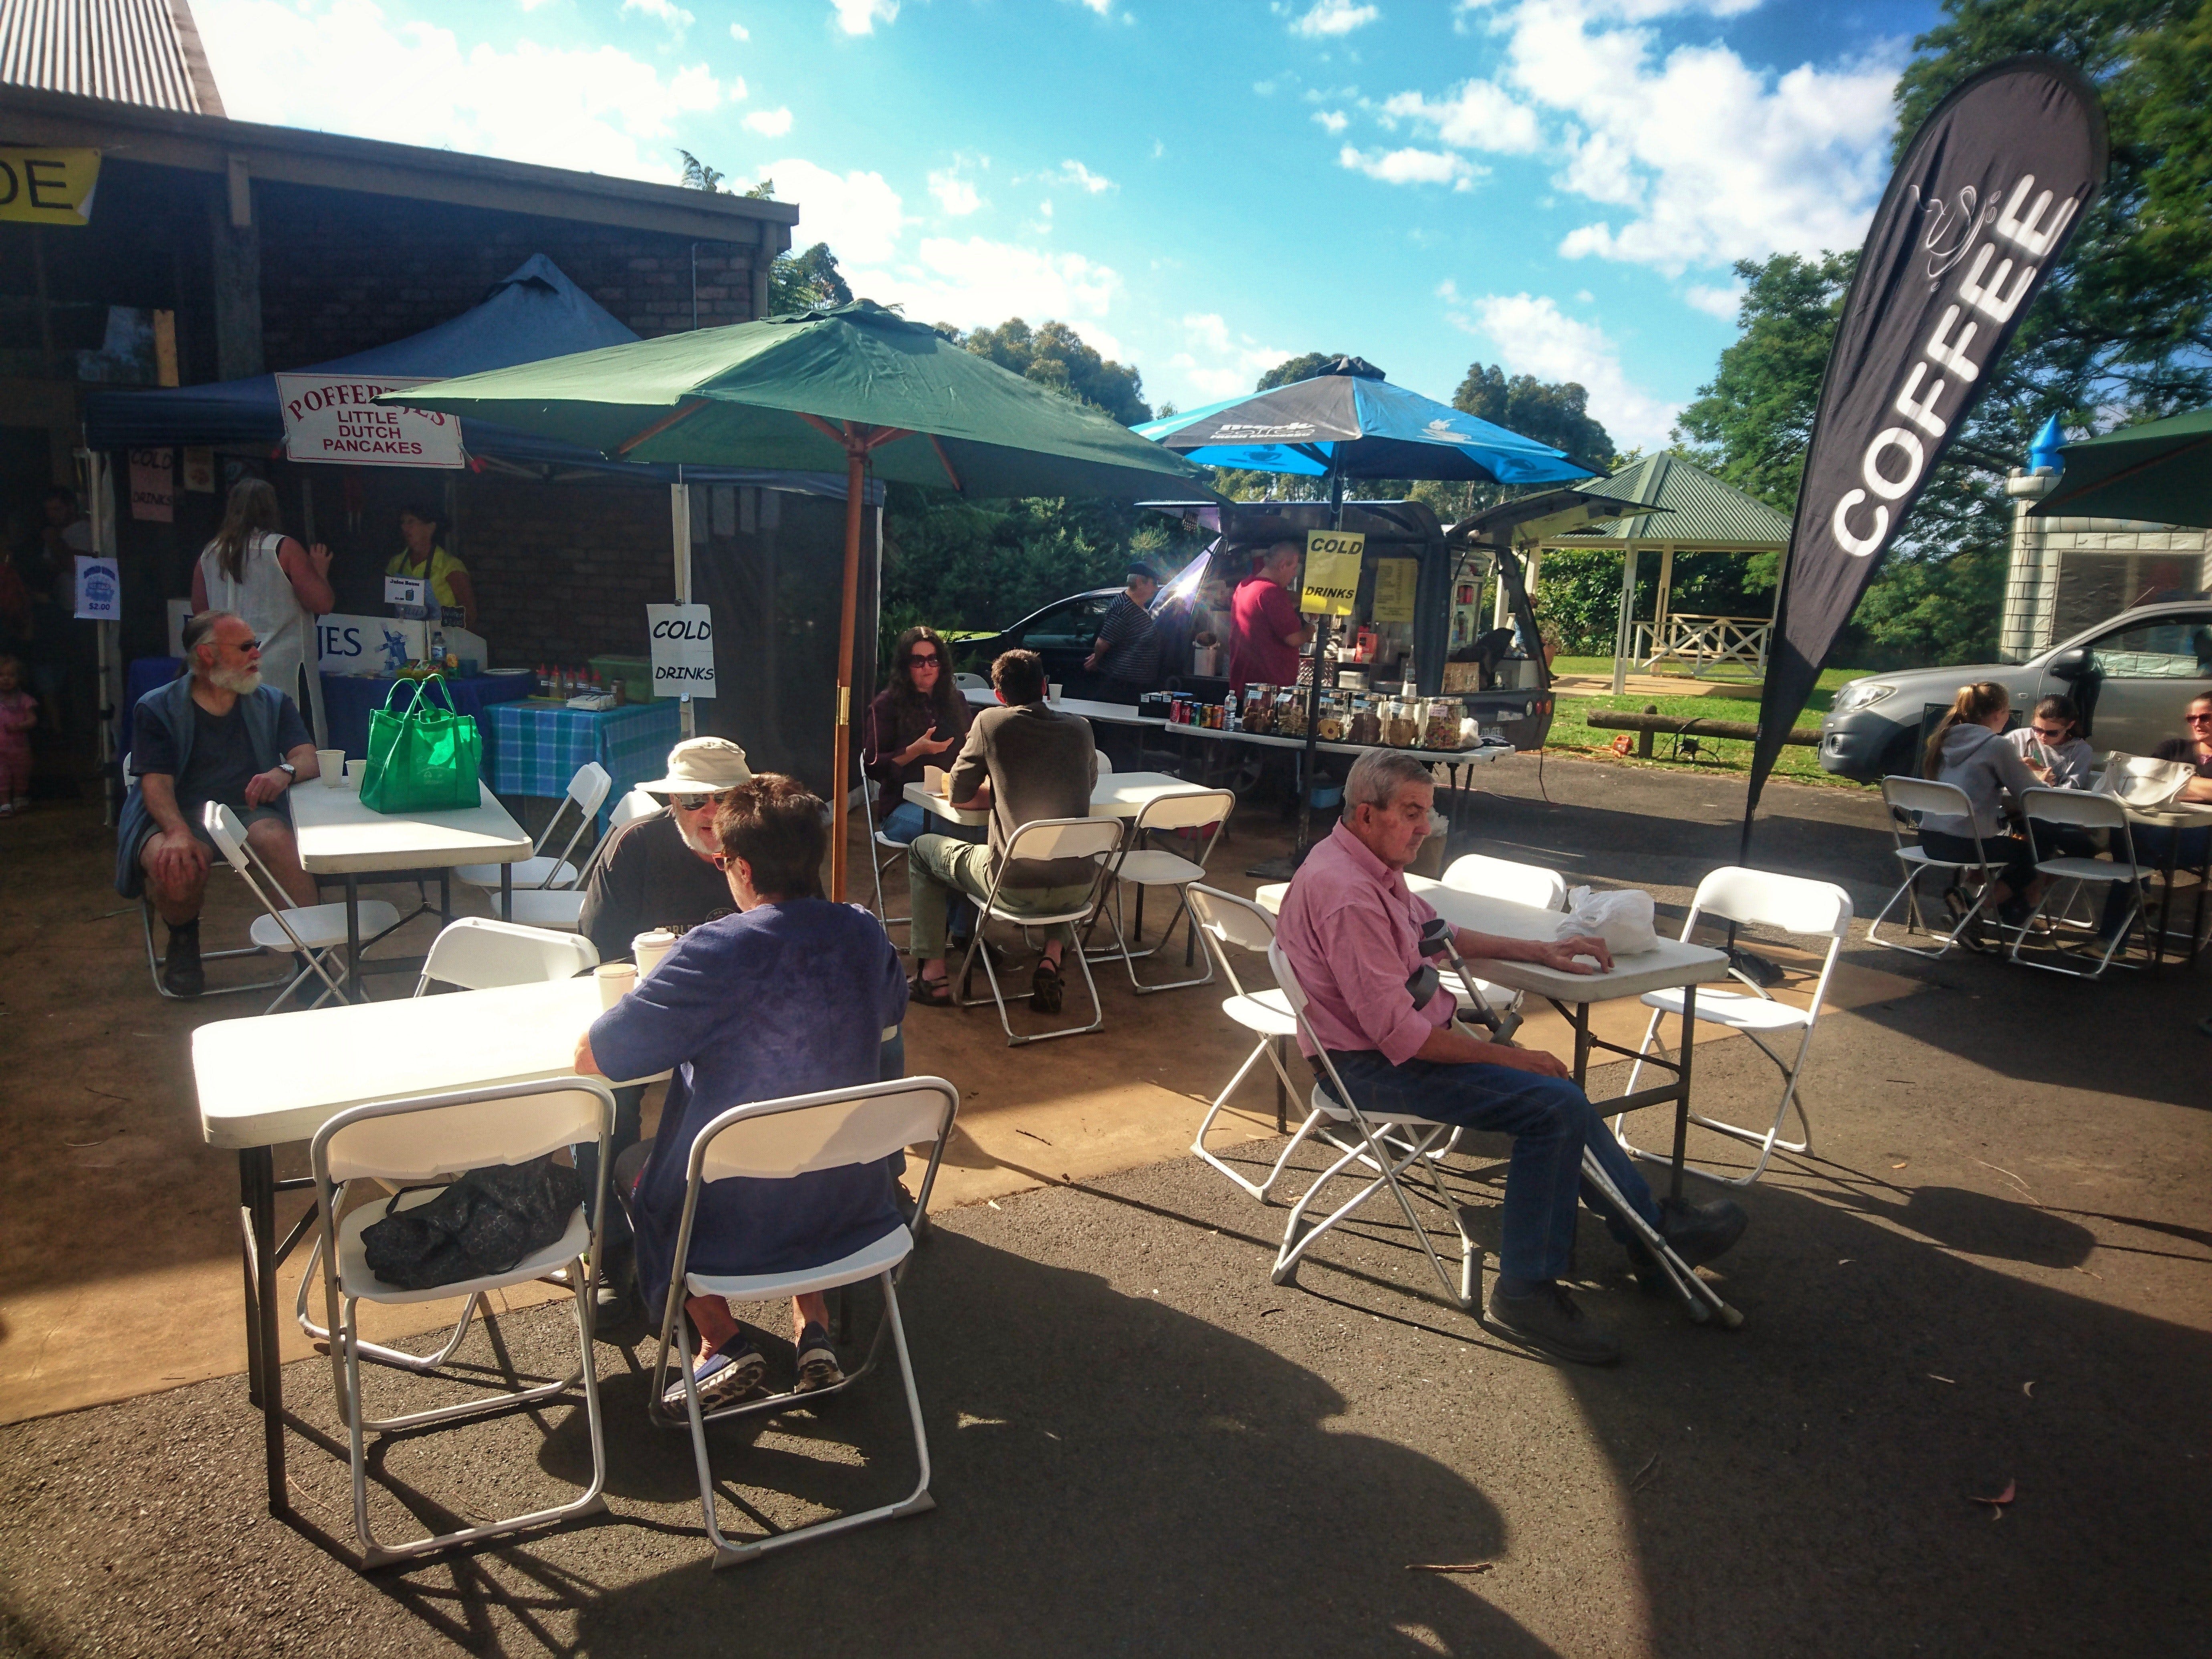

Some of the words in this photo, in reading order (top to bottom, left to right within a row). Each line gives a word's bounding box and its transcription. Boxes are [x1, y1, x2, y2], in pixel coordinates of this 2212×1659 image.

[1834, 174, 2079, 557] COFFEE
[337, 410, 398, 424] LITTLE
[339, 425, 401, 439] DUTCH
[323, 438, 422, 454] PANCAKES
[131, 450, 173, 469] COLD
[133, 492, 173, 506] DRINKS
[1311, 538, 1363, 555] COLD
[1305, 586, 1355, 599] DRINKS
[89, 602, 110, 611] $2.00
[653, 620, 711, 640] COLD
[655, 666, 714, 680] DRINKS
